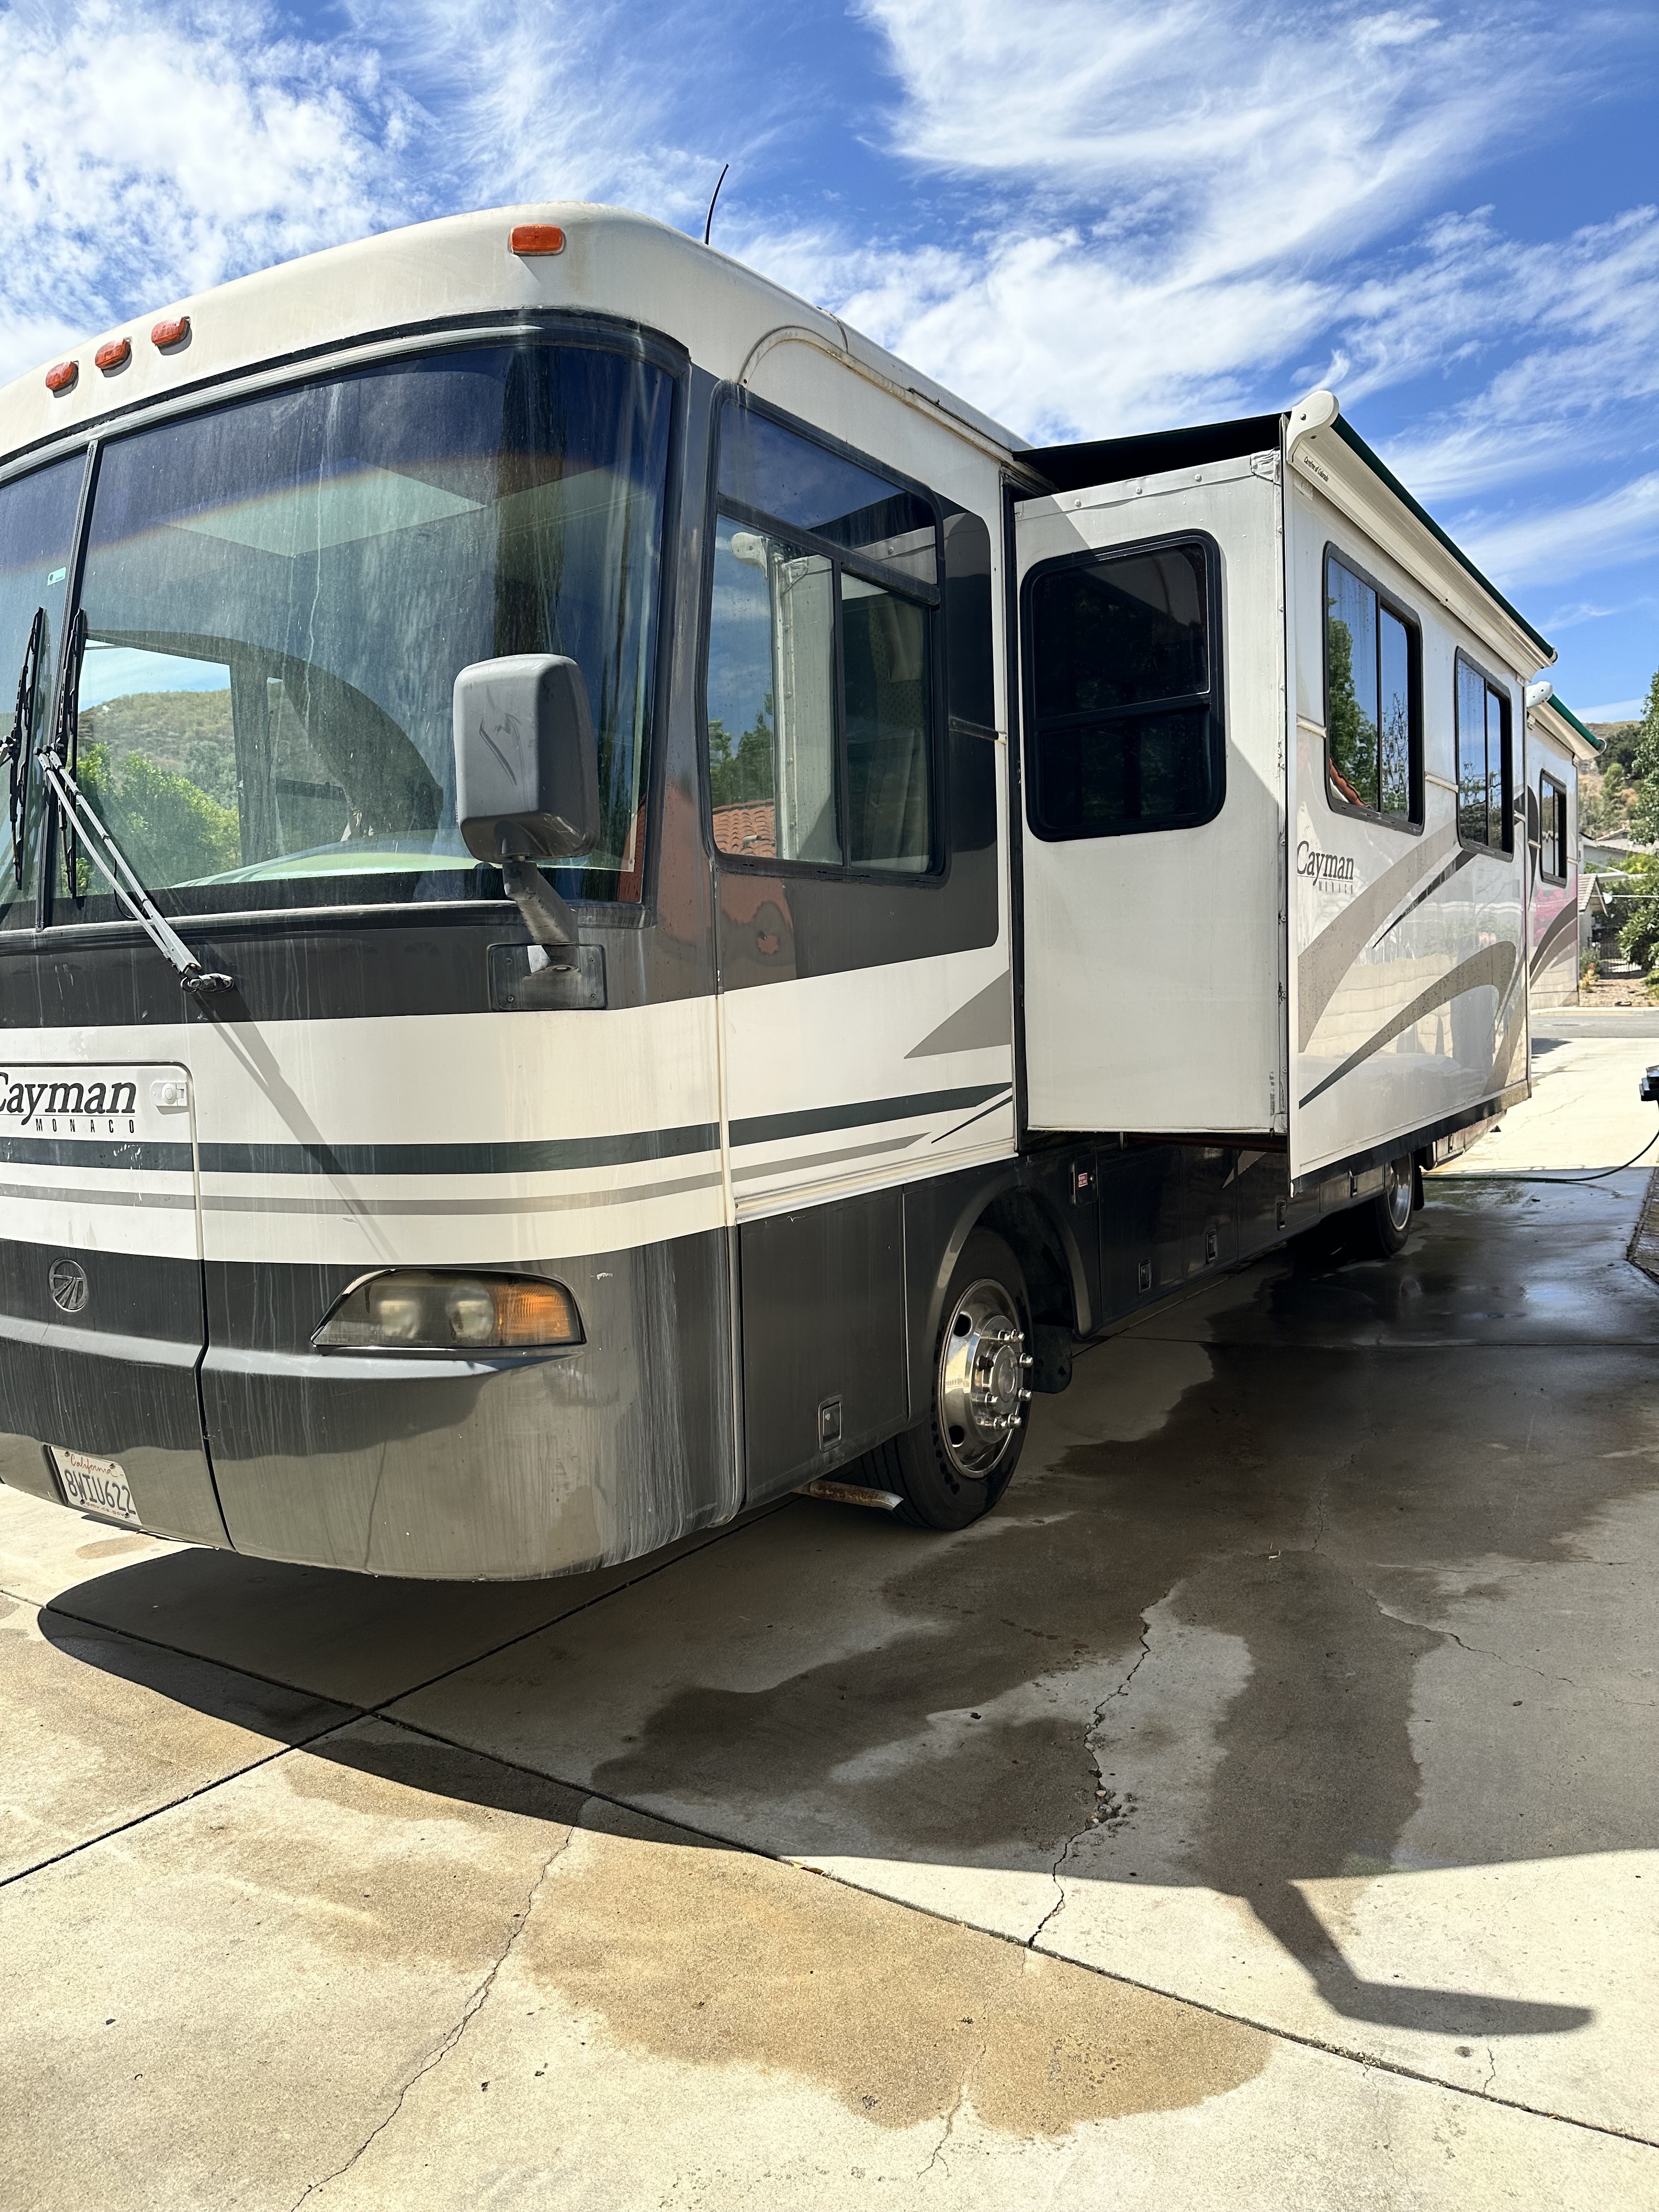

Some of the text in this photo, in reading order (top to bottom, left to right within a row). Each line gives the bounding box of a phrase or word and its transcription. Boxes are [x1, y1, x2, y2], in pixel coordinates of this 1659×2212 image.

[1297, 840, 1354, 886] Cayman
[35, 1118, 135, 1133] MONACO
[70, 1453, 118, 1478] California
[64, 1470, 136, 1515] 8WIU622
